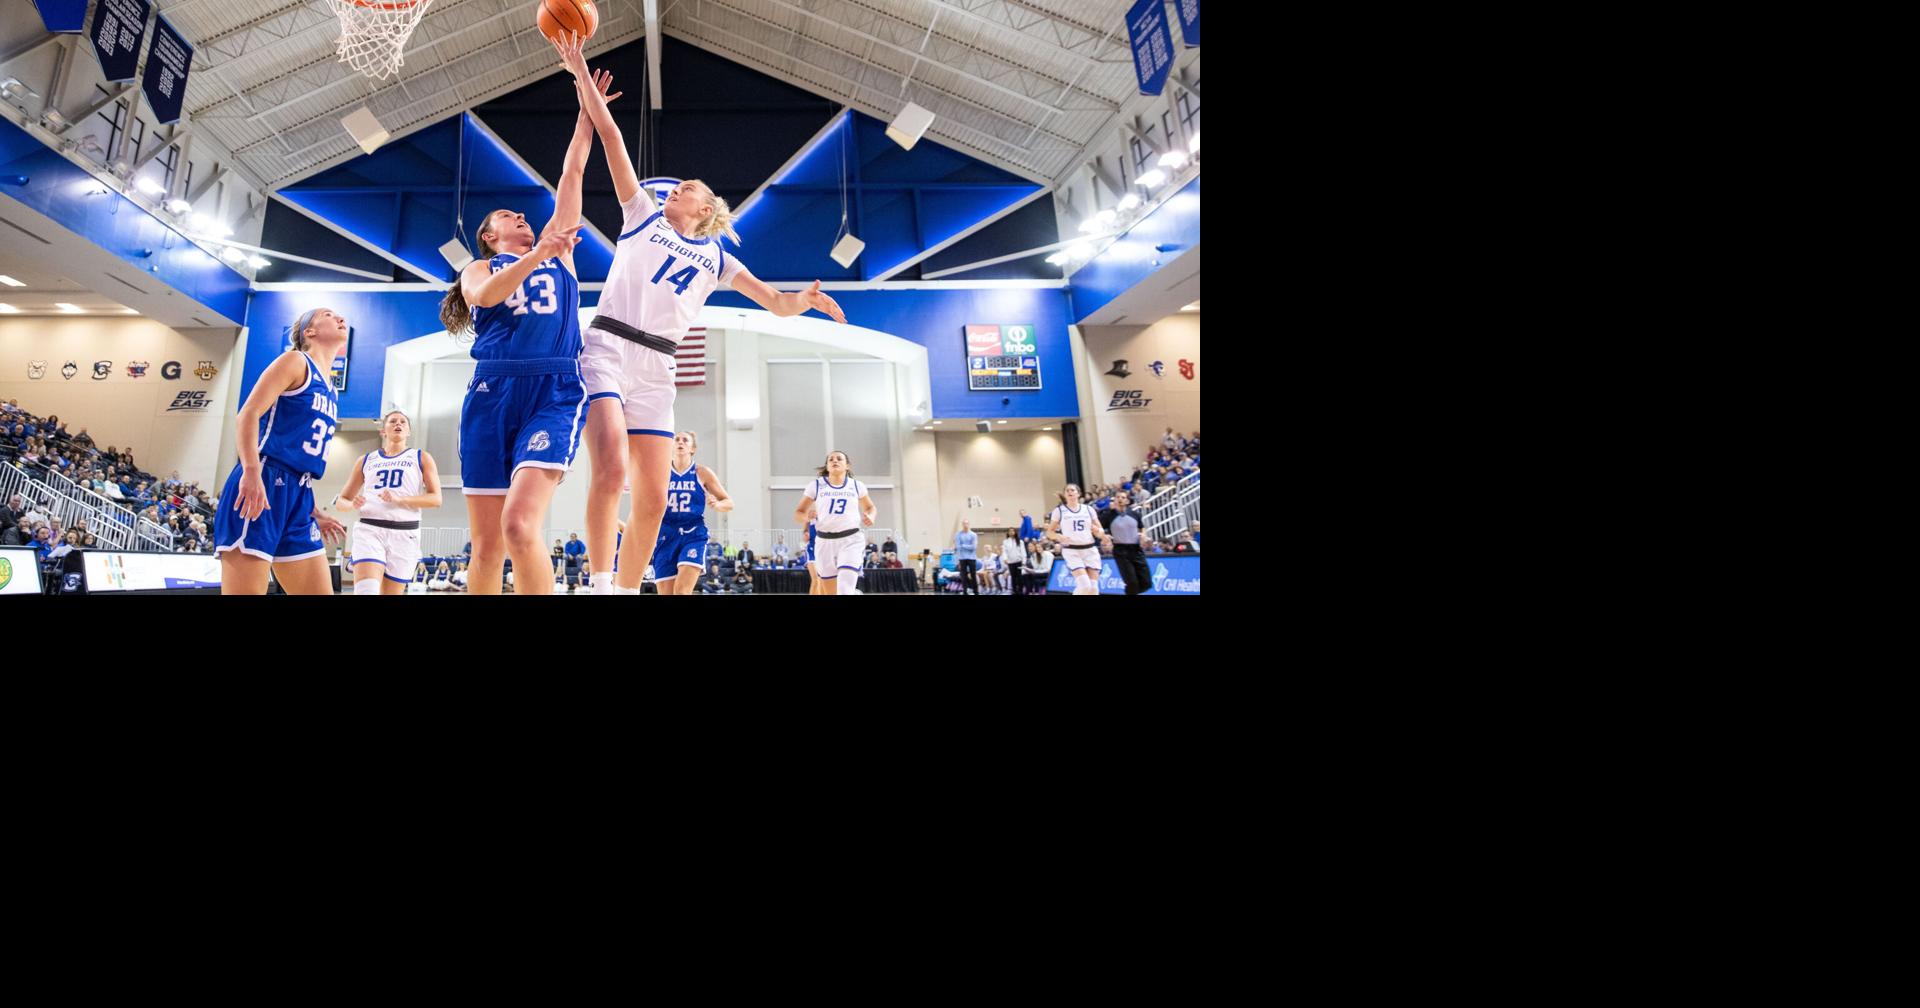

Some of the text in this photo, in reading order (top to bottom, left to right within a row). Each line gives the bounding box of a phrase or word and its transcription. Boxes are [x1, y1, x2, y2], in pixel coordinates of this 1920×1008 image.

[650, 254, 700, 296] 14
[504, 273, 558, 316] 43
[161, 360, 182, 380] G
[170, 399, 213, 407] EAST
[176, 390, 207, 399] BIG
[1109, 399, 1152, 407] EAST
[1113, 390, 1143, 399] BIG
[311, 392, 338, 422] DRA
[374, 468, 405, 490] 30
[668, 480, 696, 491] RAKE
[668, 492, 692, 513] 42
[829, 498, 848, 515] 13
[1072, 519, 1086, 532] 15
